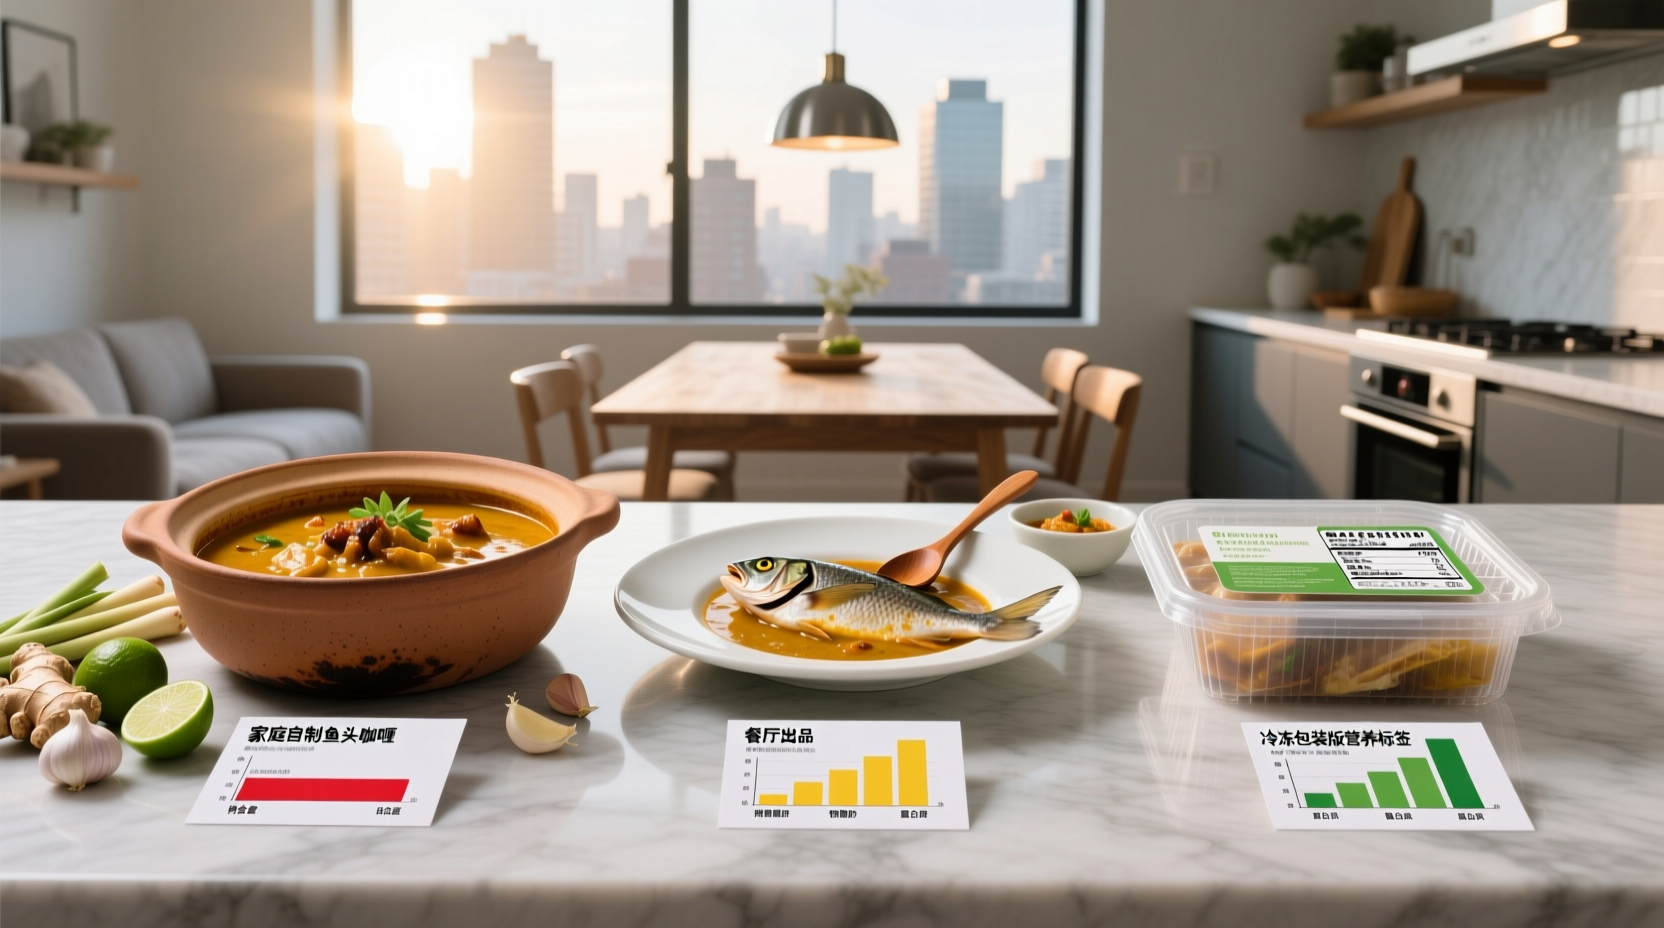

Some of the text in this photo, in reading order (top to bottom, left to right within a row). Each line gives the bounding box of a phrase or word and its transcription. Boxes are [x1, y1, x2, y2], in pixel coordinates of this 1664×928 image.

[248, 725, 397, 743] 家庭自制鱼头咖喱
[745, 727, 814, 744] 餐厅出品
[1259, 729, 1412, 747] 冷冻包装版营养标签
